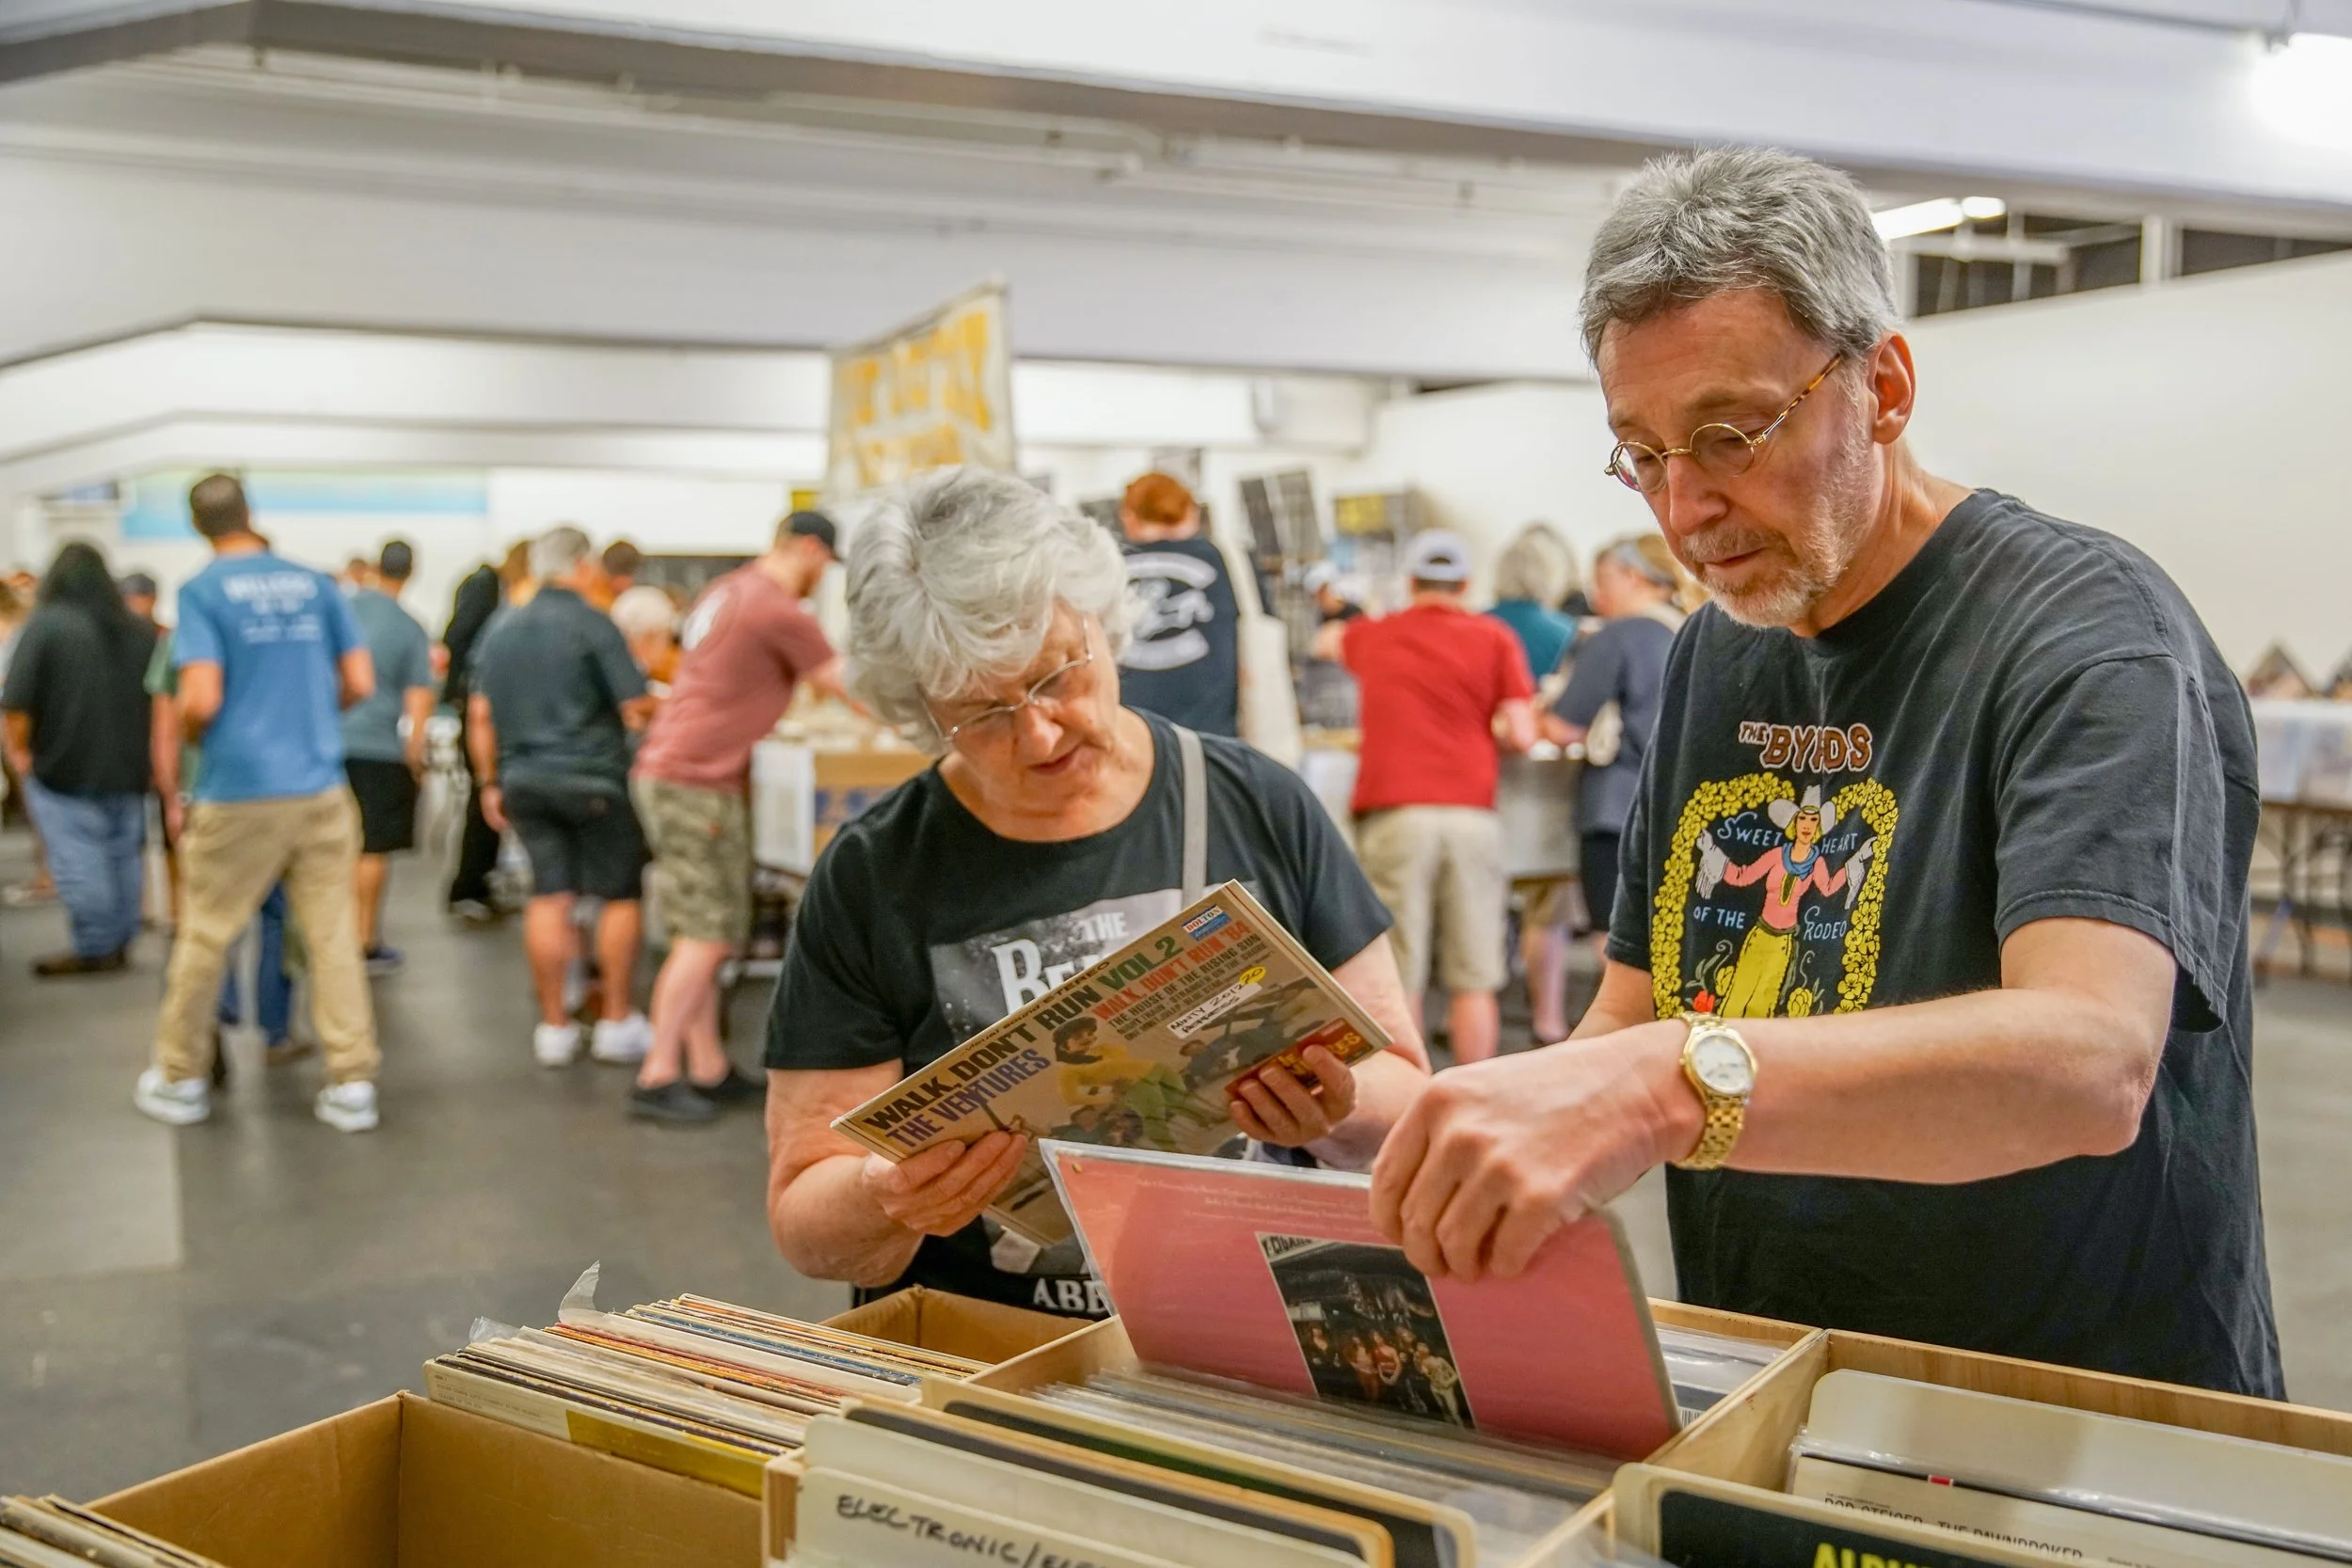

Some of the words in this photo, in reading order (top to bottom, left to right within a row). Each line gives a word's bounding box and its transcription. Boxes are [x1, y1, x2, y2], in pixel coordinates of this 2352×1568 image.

[1740, 721, 1768, 744] THE
[1821, 833, 1858, 853] HEART
[1079, 911, 1128, 942] THE
[1185, 908, 1221, 931] DOLTON
[1693, 907, 1709, 919] OF
[1717, 908, 1744, 929] THE
[1804, 906, 1847, 940] RODEO
[1185, 936, 1226, 964] RUN
[1044, 961, 1110, 1004] STEREO
[1108, 1013, 1130, 1028] THE
[1128, 991, 1165, 1016] HOUSE
[1163, 983, 1178, 996] OF
[1178, 970, 1201, 986] THE
[1199, 947, 1238, 974] RISING
[1237, 933, 1262, 952] SUN
[1170, 1006, 1205, 1030] MINTY
[862, 1076, 961, 1131] WALK,
[1033, 985, 1104, 1031] RUN
[884, 1114, 945, 1148] THE
[929, 1048, 1052, 1122] VENTURES
